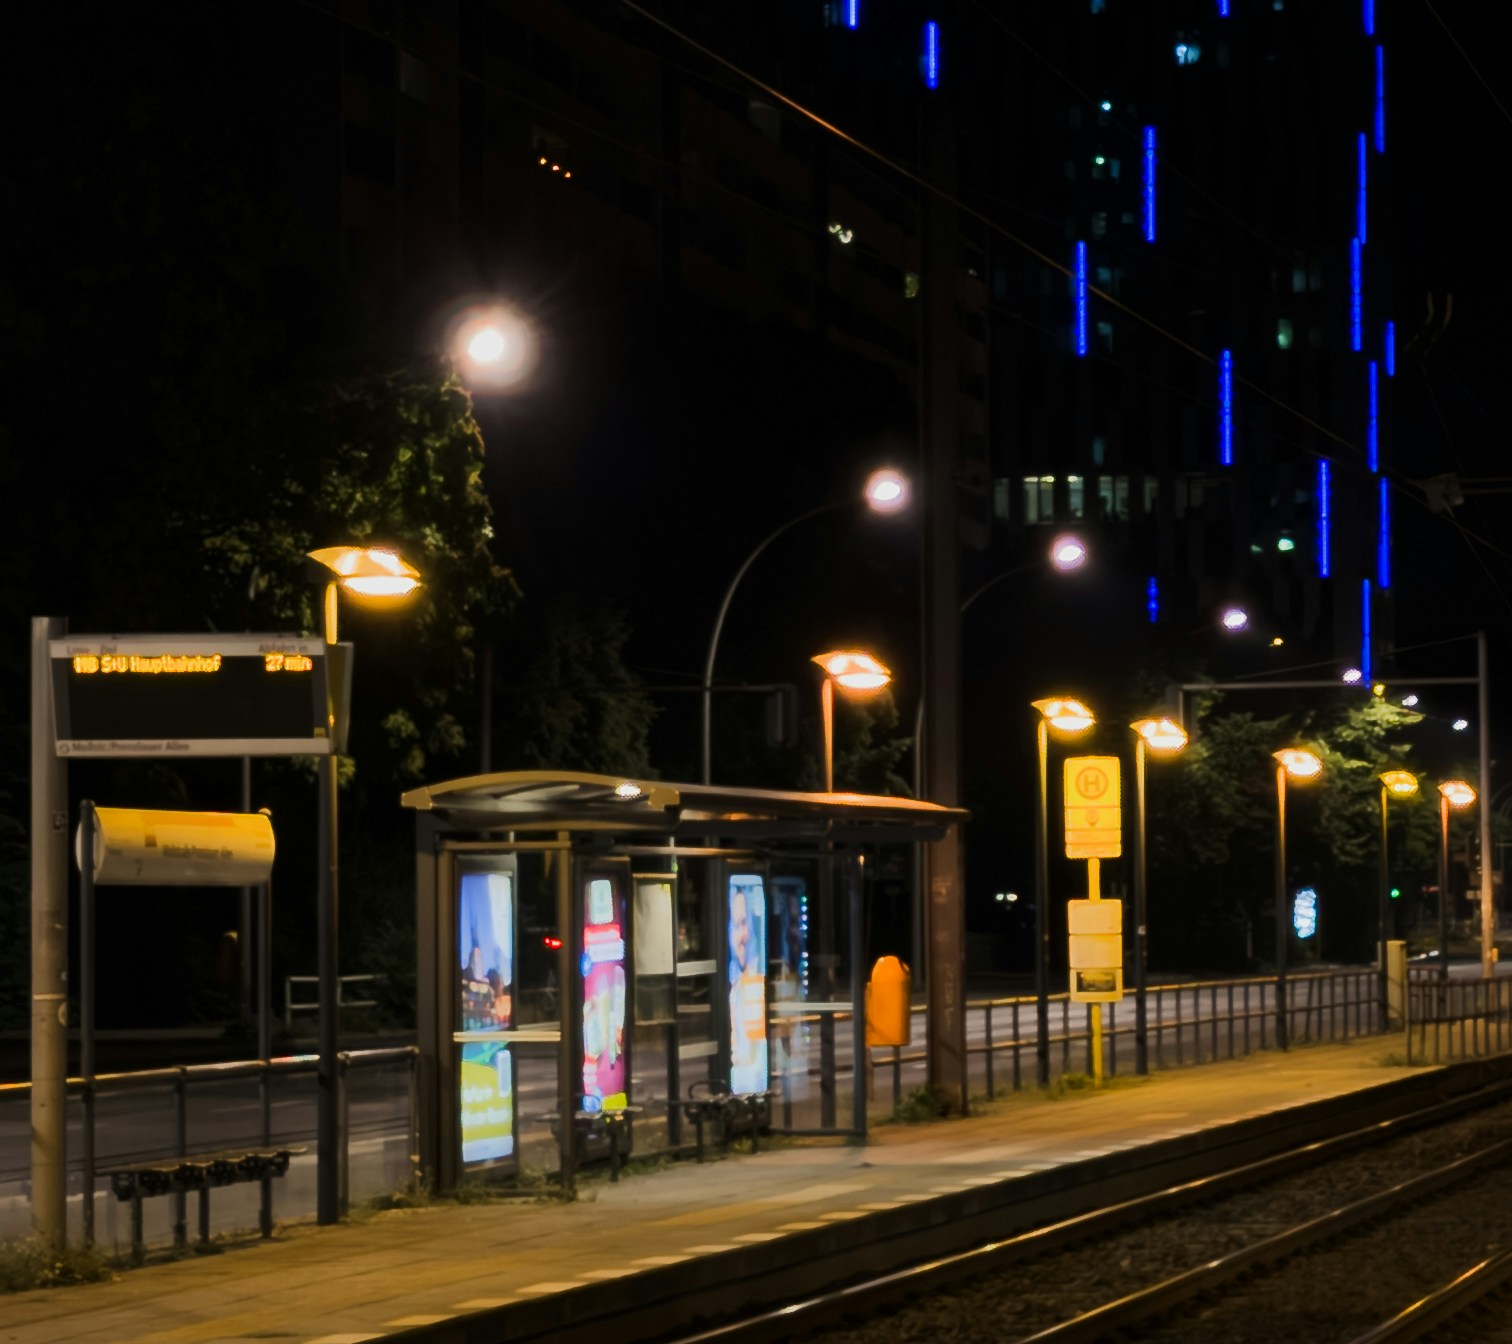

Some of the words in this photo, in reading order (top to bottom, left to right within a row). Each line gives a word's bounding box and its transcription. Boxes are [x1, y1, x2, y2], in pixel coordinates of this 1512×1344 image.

[101, 654, 129, 673] S+U
[129, 653, 222, 674] Hauptbahnhof
[265, 652, 284, 672] 27
[284, 654, 313, 672] min
[1083, 775, 1100, 793] H
